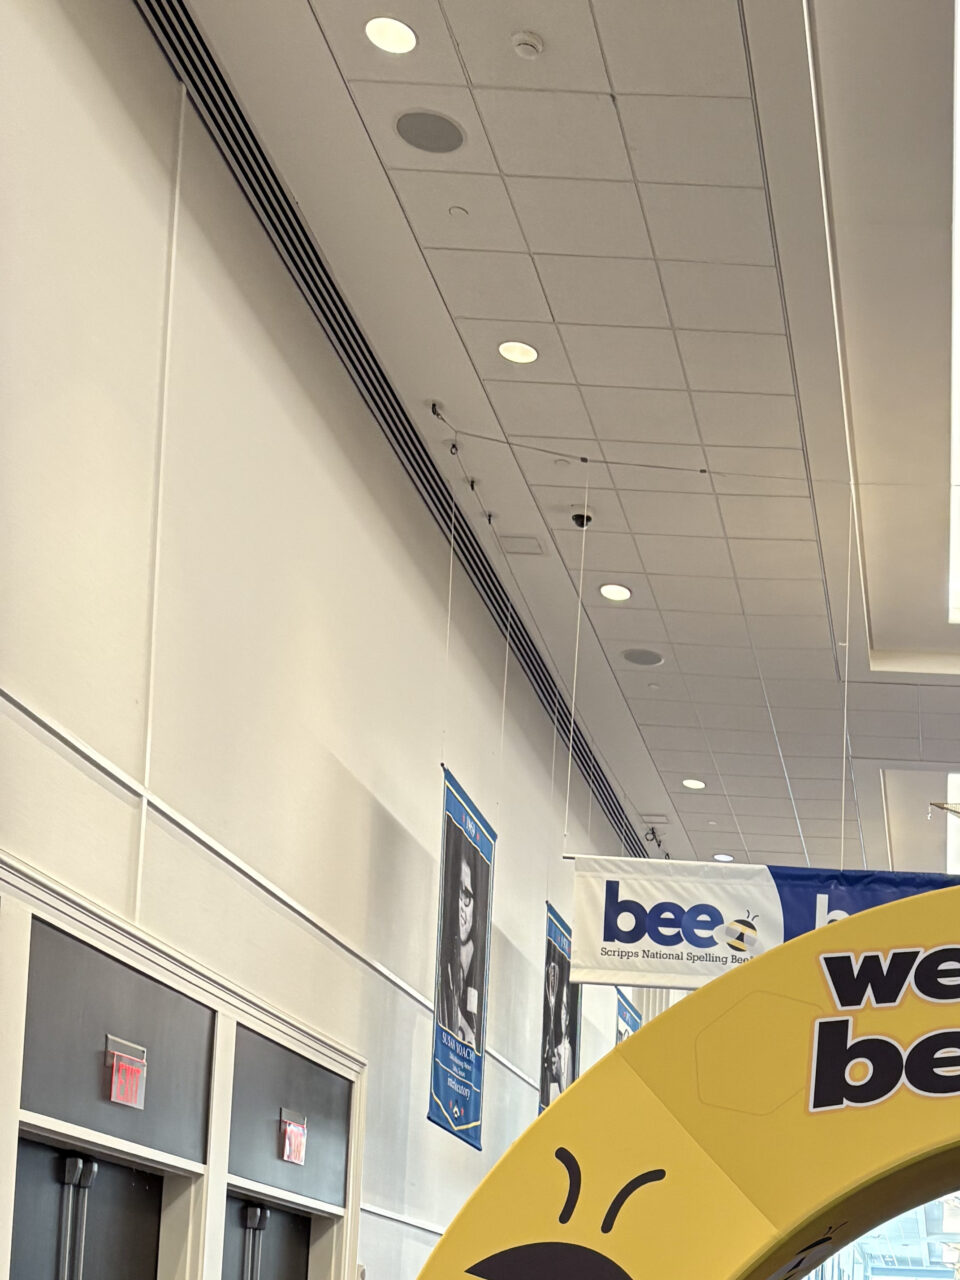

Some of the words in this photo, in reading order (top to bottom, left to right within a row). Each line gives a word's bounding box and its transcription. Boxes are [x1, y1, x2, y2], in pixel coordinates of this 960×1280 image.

[603, 879, 724, 949] bee
[600, 947, 639, 958] Scripps
[641, 949, 684, 961] National
[686, 952, 728, 966] Spelling
[117, 1062, 142, 1105] EXIT
